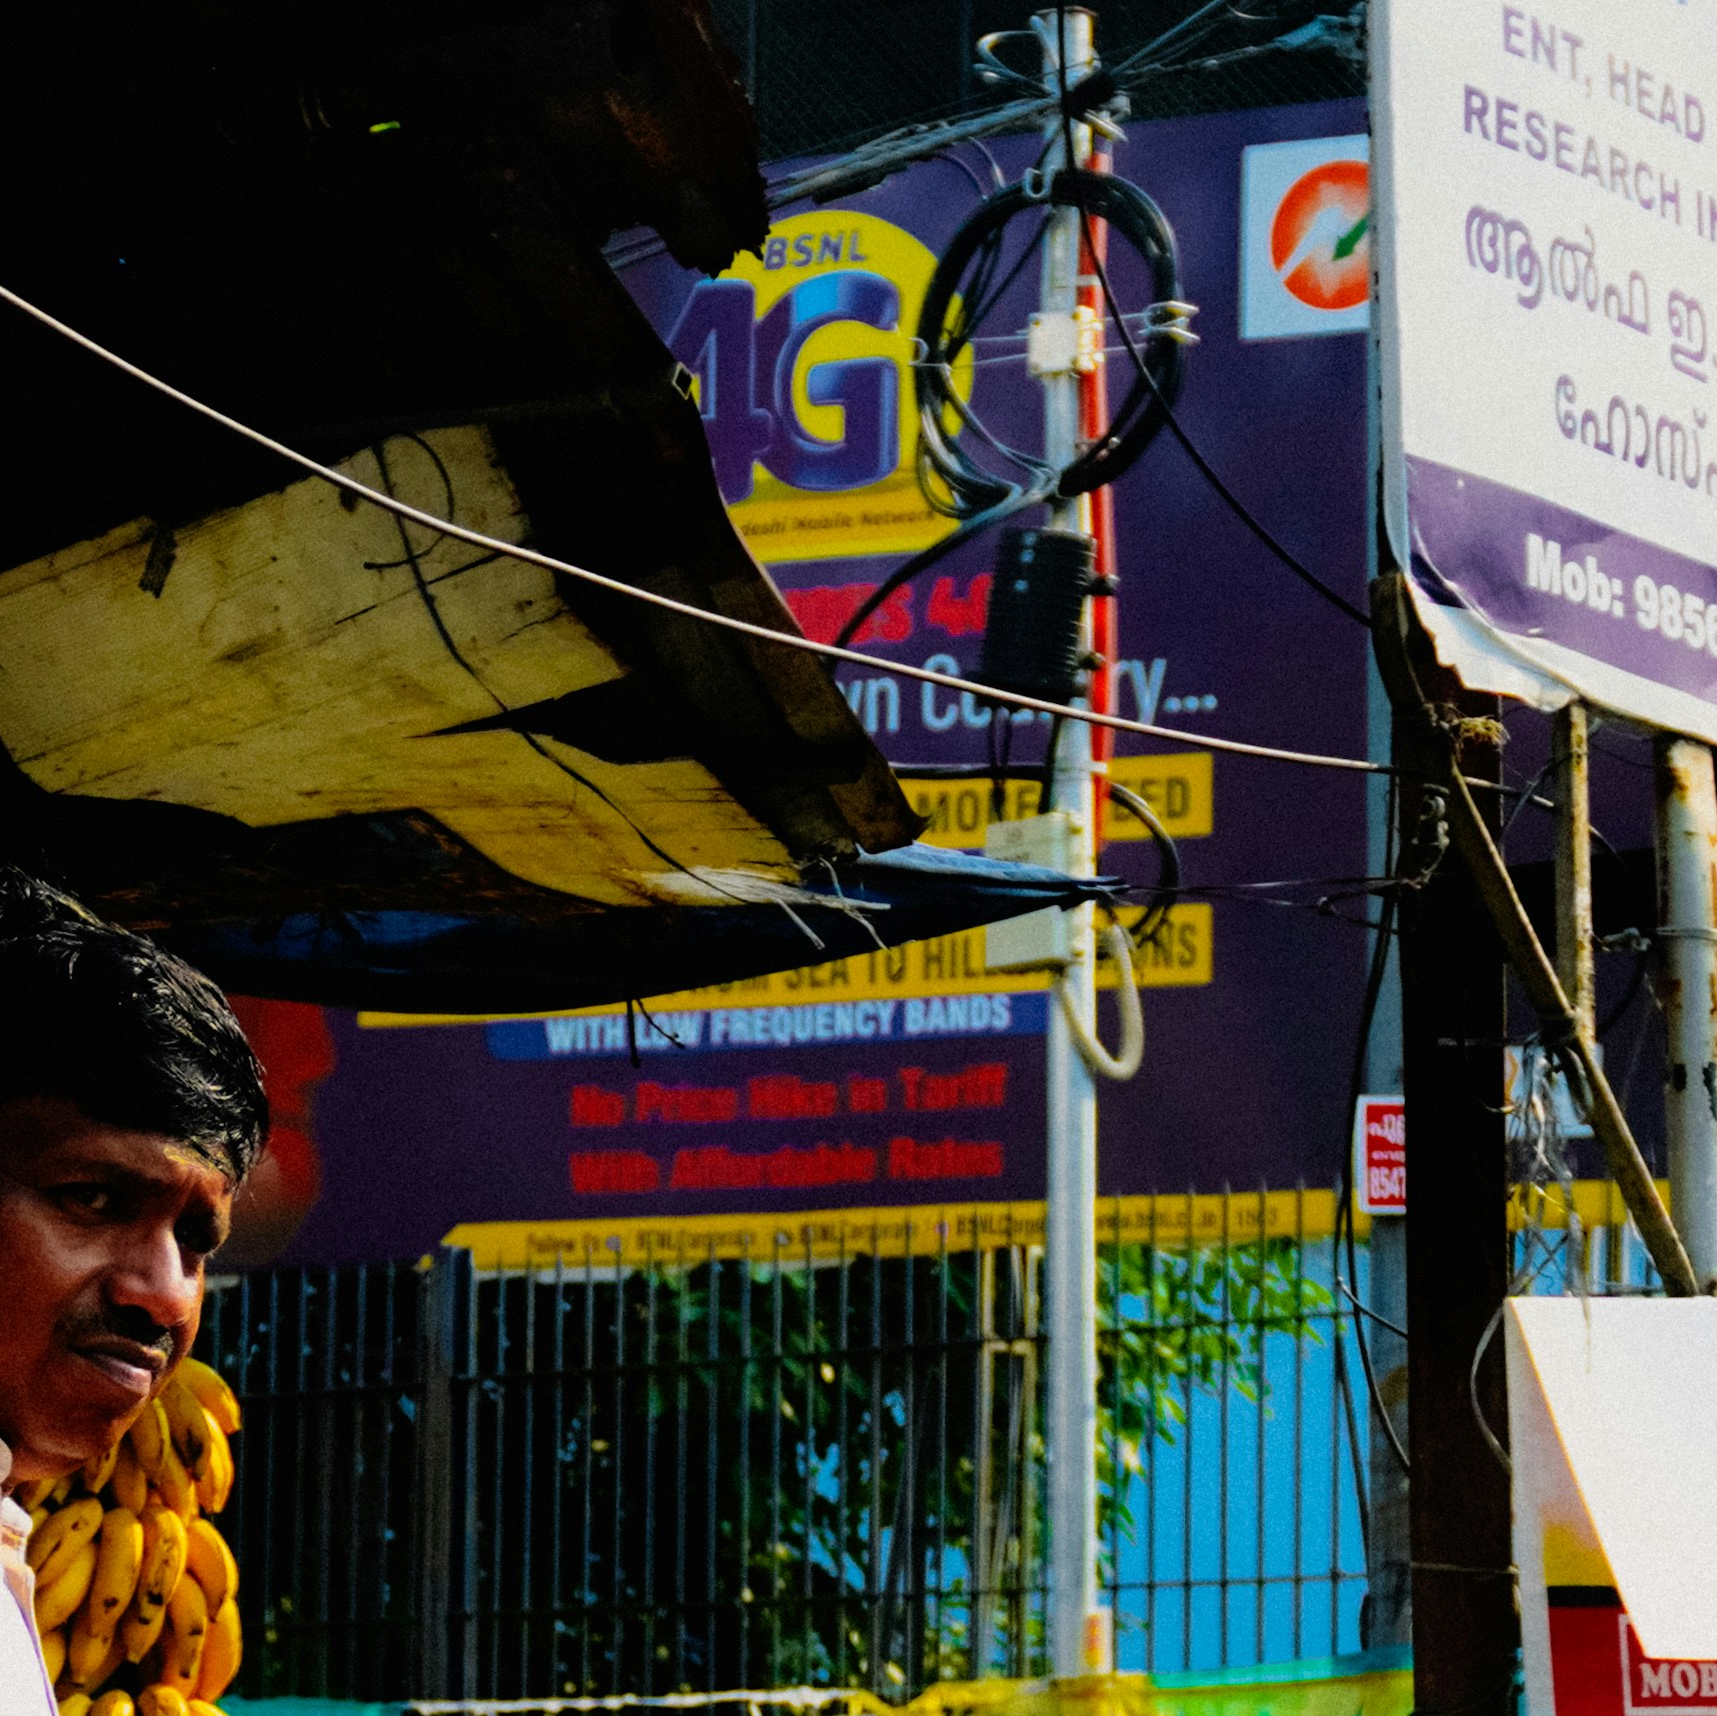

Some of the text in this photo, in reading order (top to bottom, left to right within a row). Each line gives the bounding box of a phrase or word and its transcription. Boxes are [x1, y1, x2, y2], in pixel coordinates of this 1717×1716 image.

[1502, 8, 1595, 97] ENT,
[1608, 53, 1706, 143] HEAD
[1463, 83, 1682, 224] RESEARCH
[764, 230, 867, 270] BSNL
[666, 268, 900, 506] 4G
[1526, 533, 1624, 614] Mob:
[545, 996, 1012, 1053] WITH LOW FREQUENCY BANDS
[570, 1085, 624, 1127] No
[901, 1063, 1008, 1110] Tariff
